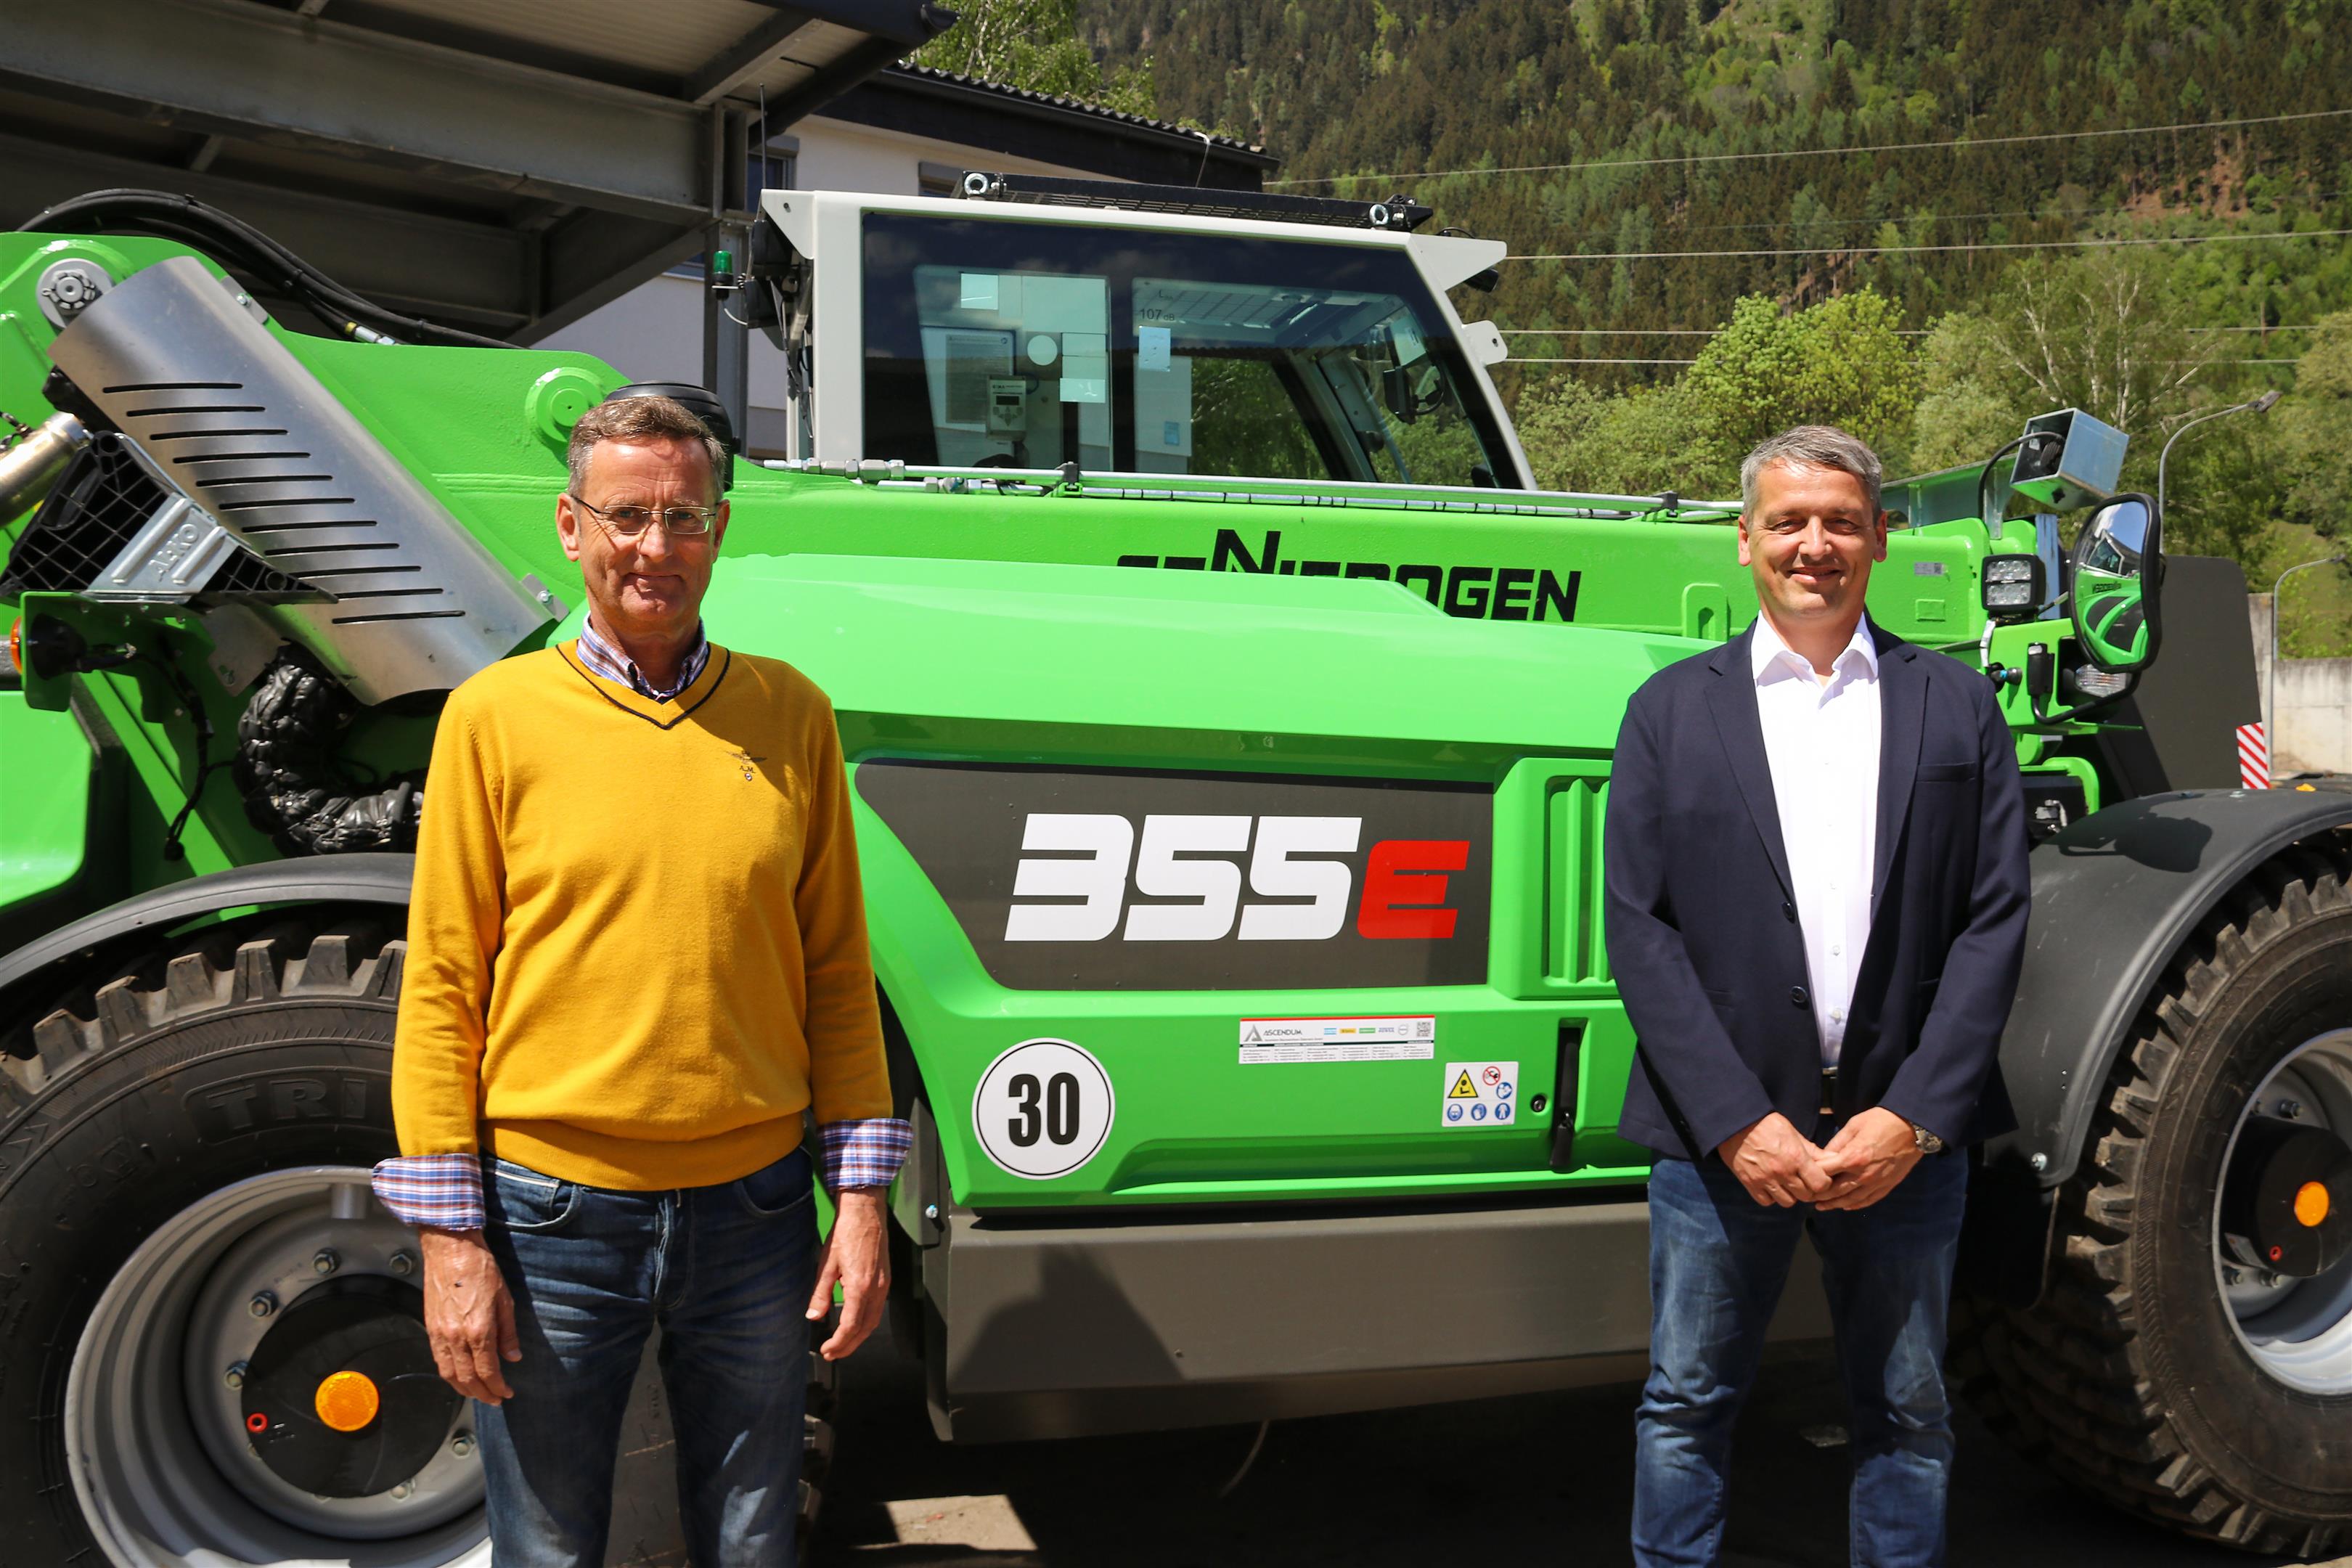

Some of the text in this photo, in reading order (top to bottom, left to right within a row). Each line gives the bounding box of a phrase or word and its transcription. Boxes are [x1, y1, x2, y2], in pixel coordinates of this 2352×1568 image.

[1139, 308, 1162, 321] 107
[1005, 814, 1469, 942] 355E
[206, 1078, 368, 1130] TRI
[1008, 1072, 1080, 1148] 30
